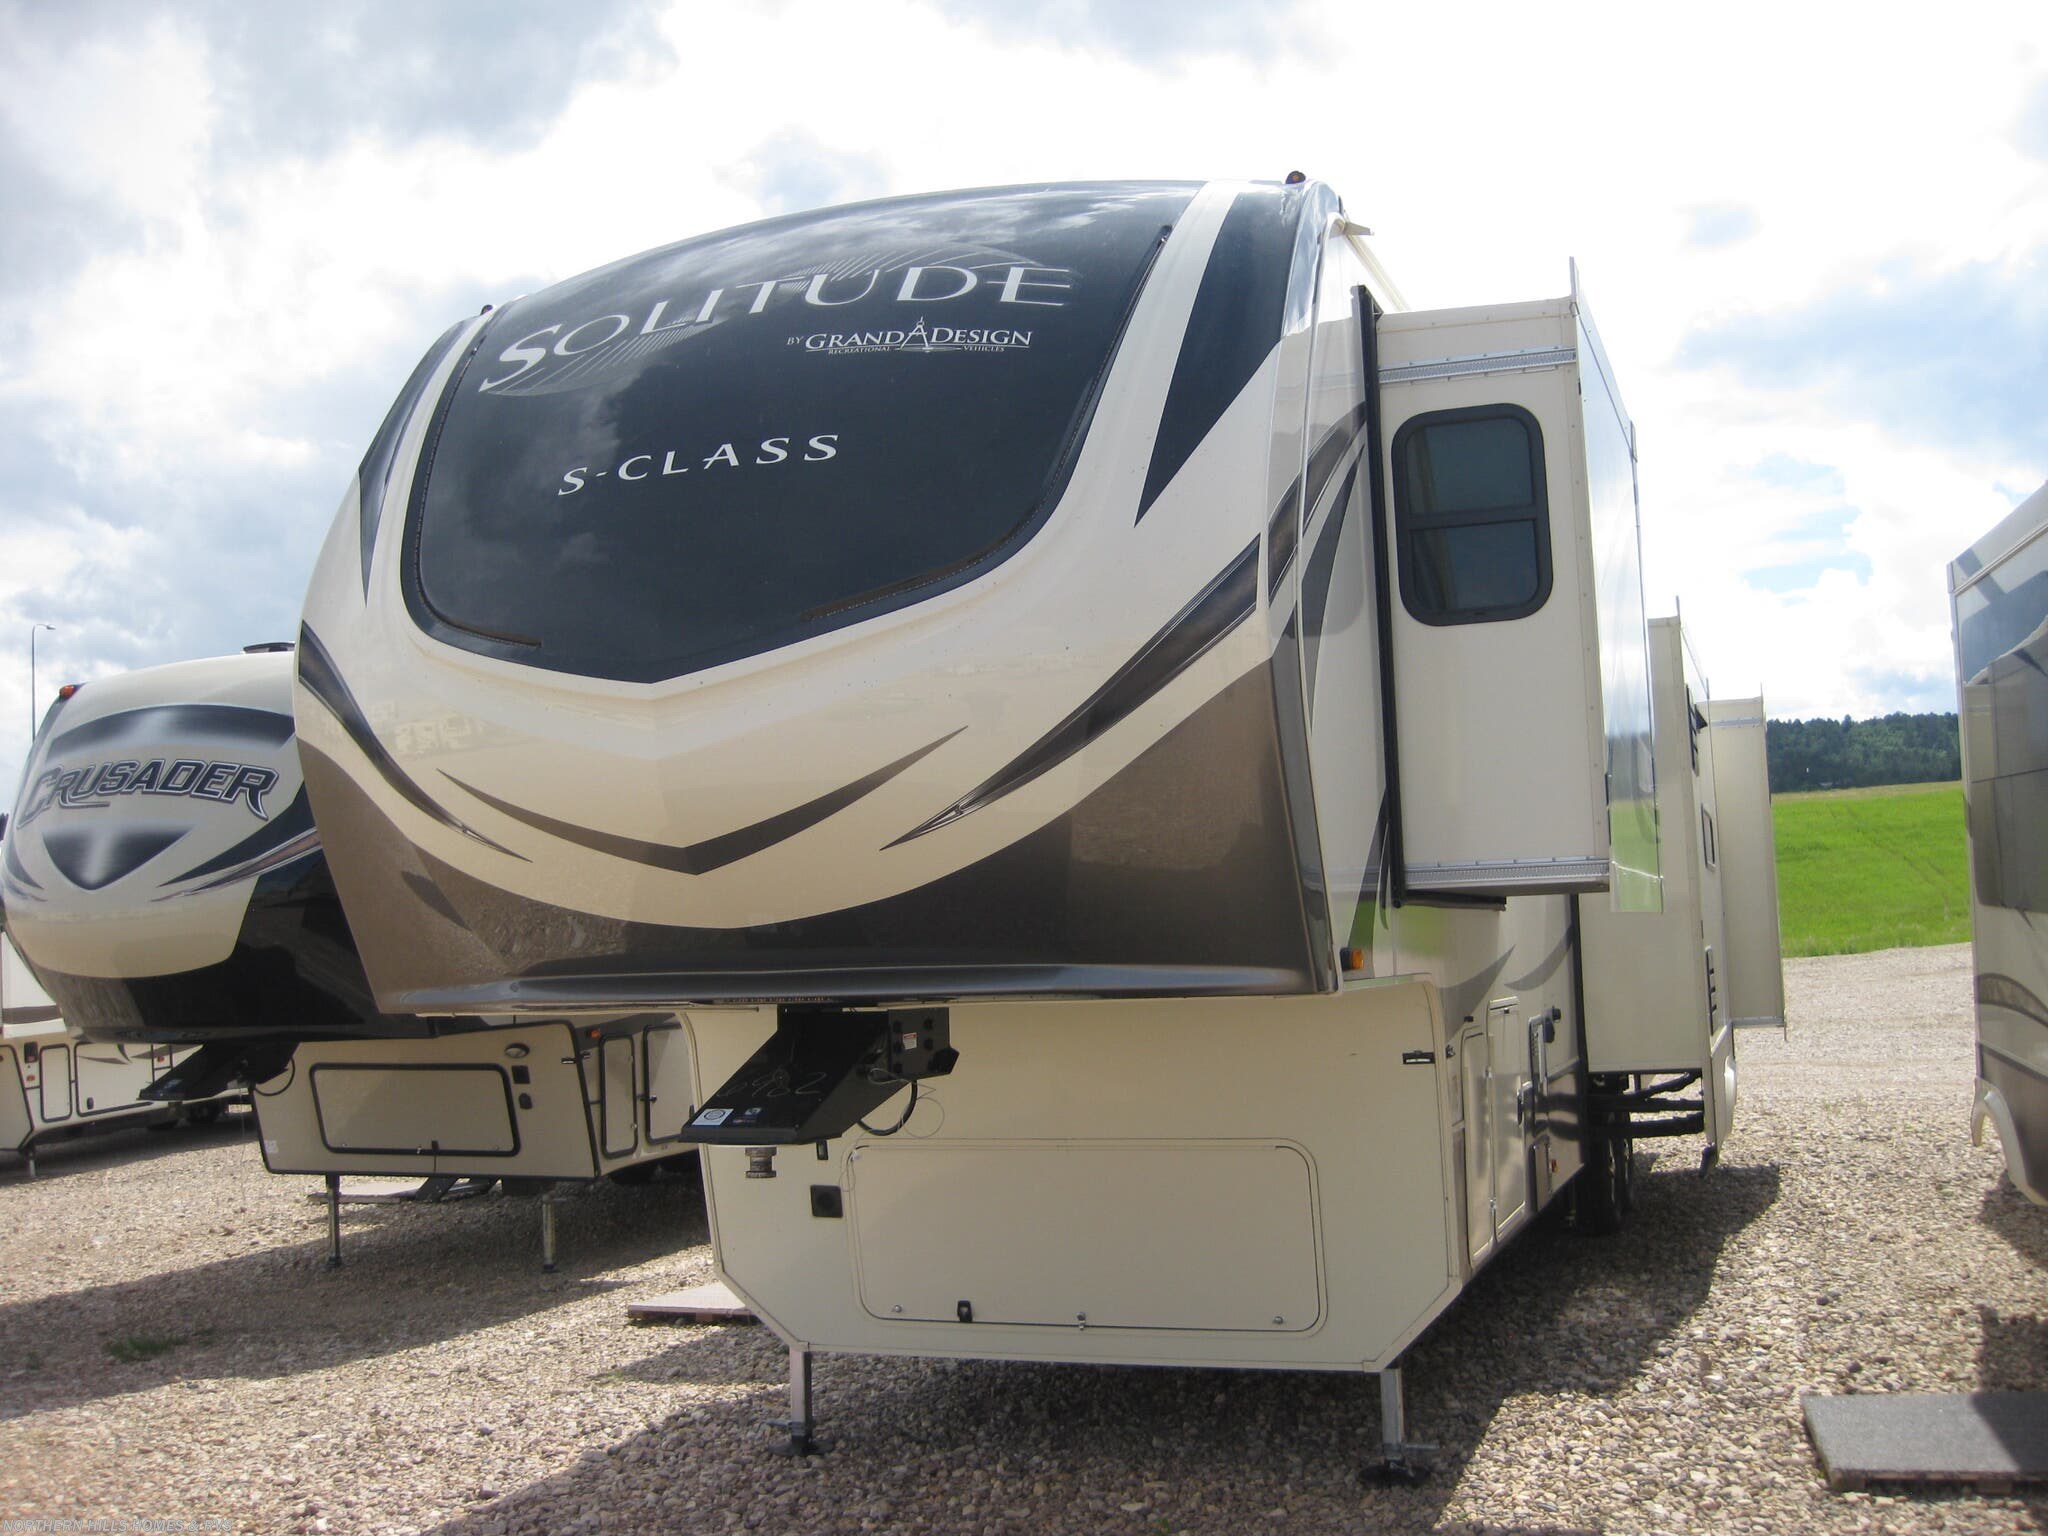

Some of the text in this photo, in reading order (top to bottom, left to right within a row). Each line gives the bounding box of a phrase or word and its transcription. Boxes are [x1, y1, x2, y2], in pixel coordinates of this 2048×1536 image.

[478, 265, 1072, 393] SOLITUDE
[786, 327, 1033, 350] BY GRAND DESIGN
[828, 344, 1006, 355] RECREATIONAL VEHICLES
[557, 433, 841, 497] S-CLASS
[16, 757, 280, 830] CRUSADER
